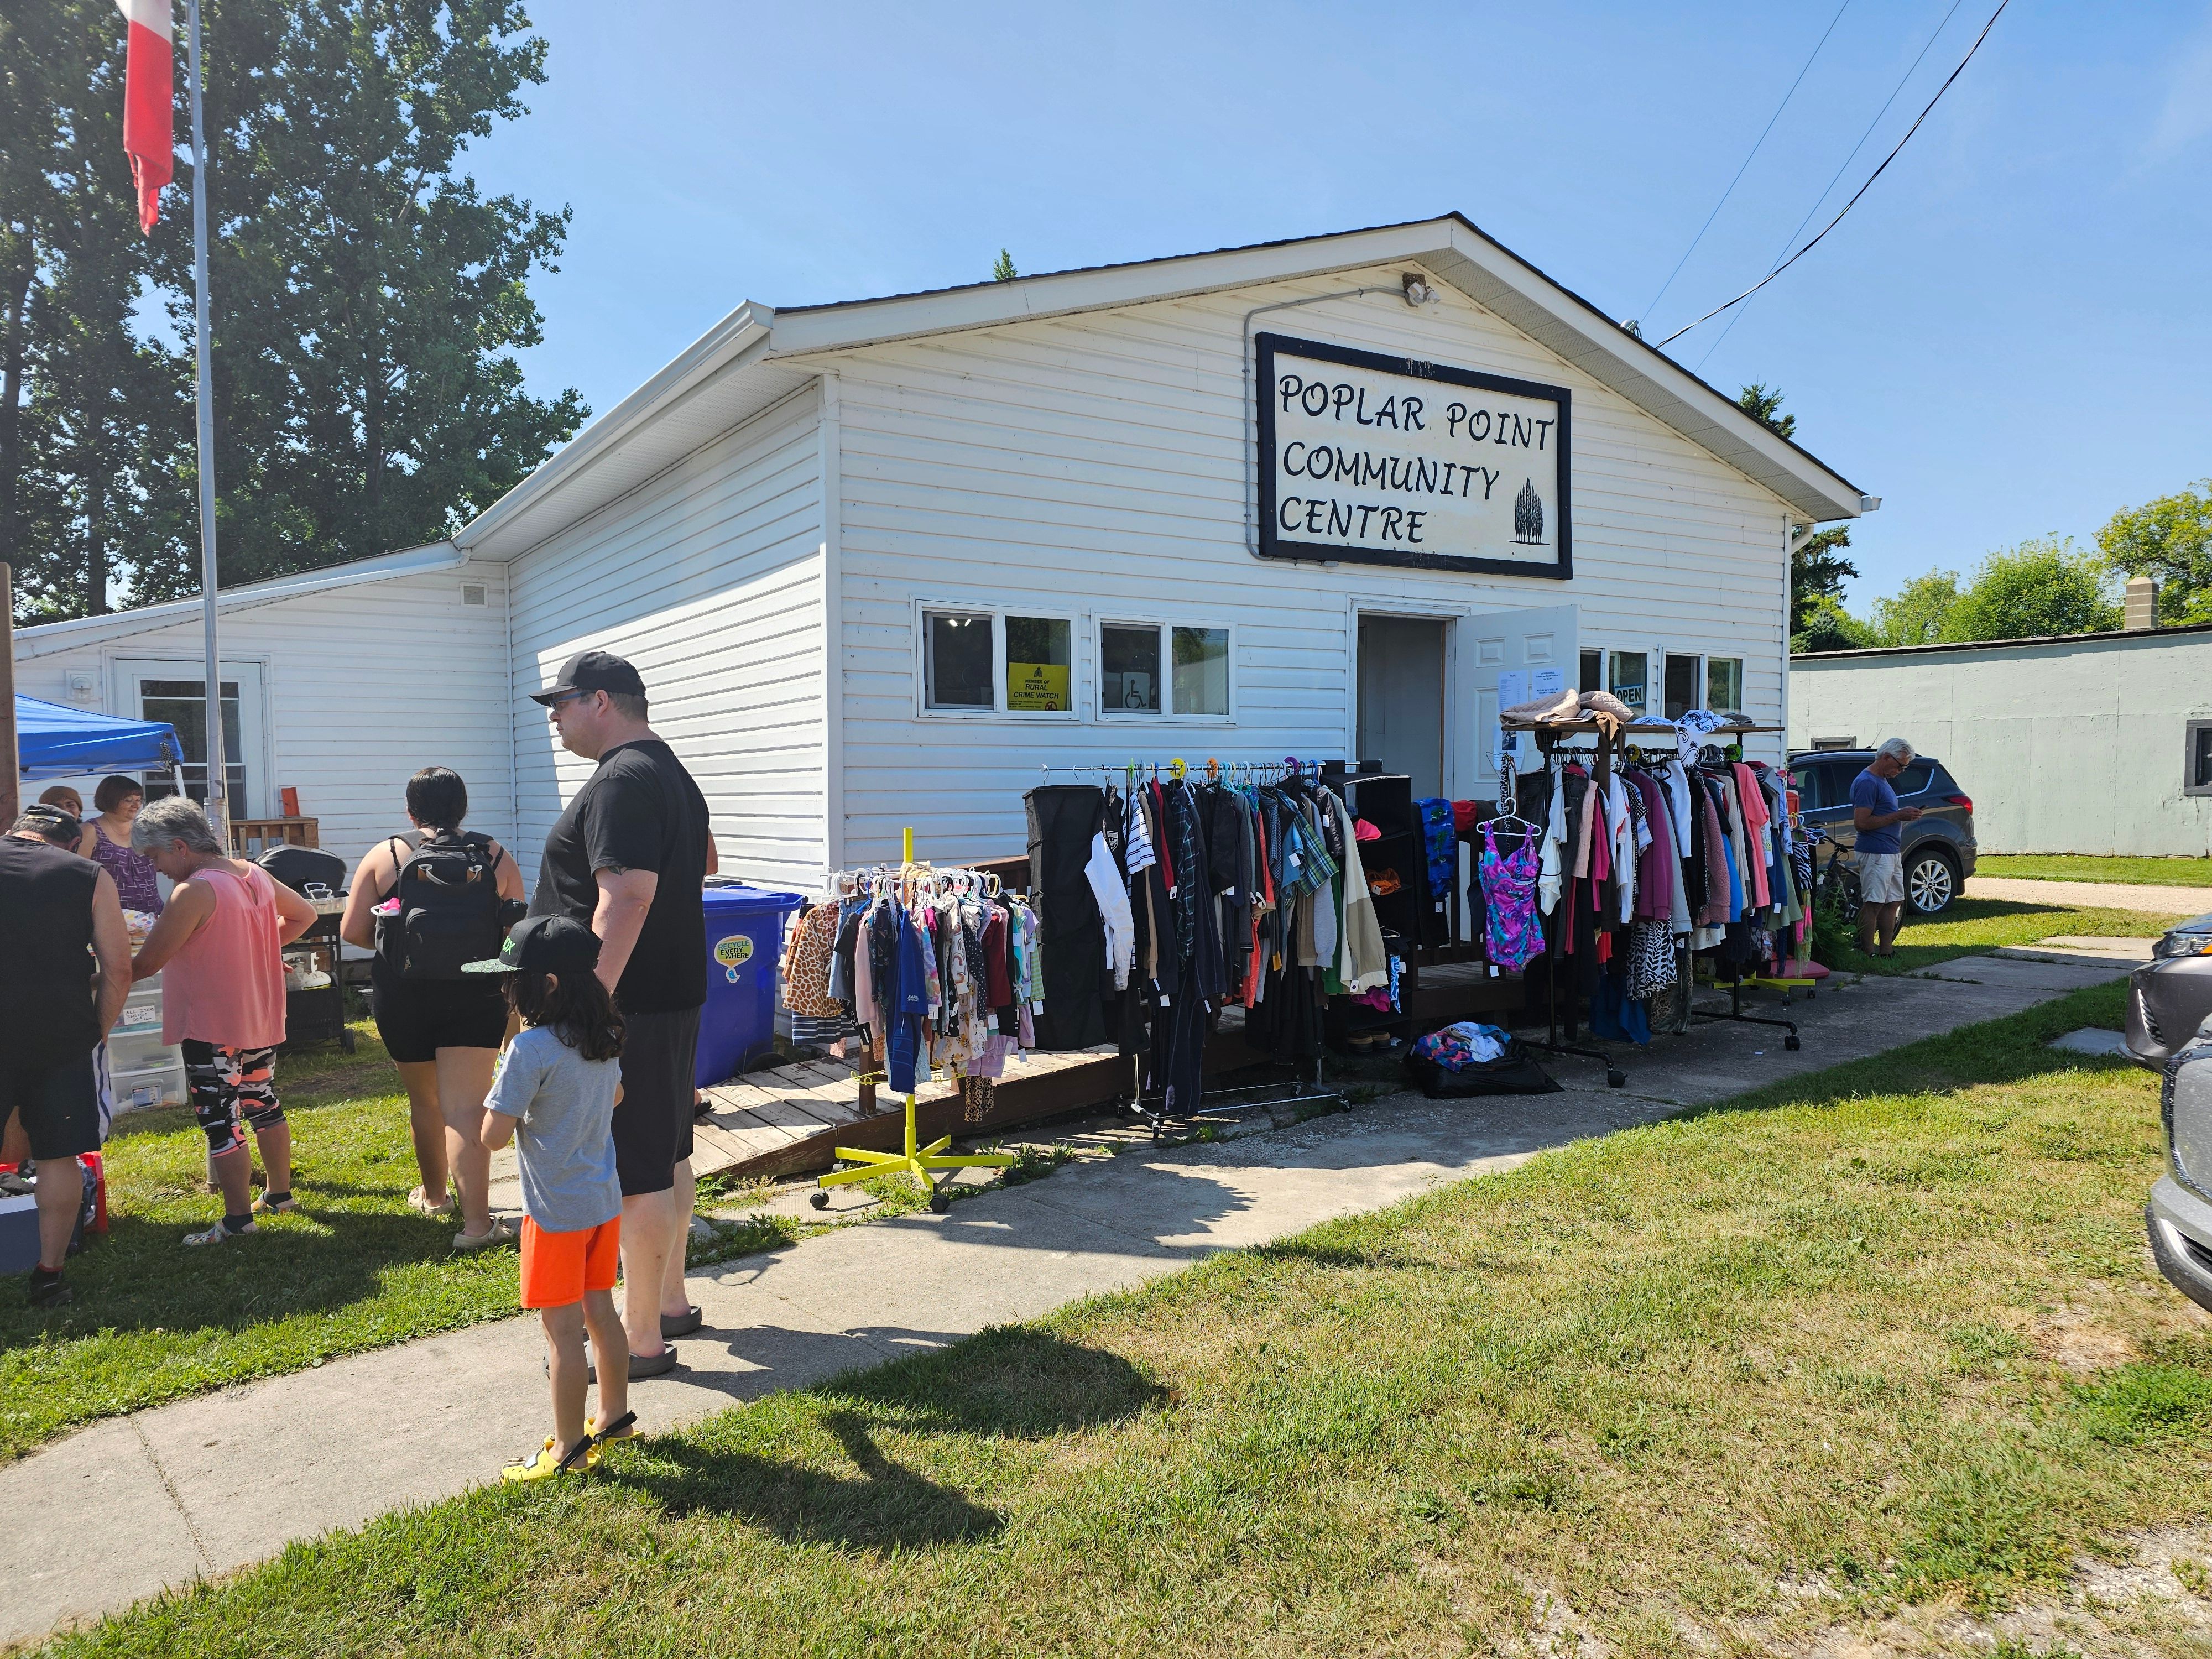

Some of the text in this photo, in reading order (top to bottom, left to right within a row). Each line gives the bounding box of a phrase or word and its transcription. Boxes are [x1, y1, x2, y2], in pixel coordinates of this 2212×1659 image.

[1280, 374, 1554, 451] POPLAR POINT
[1284, 441, 1500, 500] COMMUNITY
[1279, 496, 1427, 544] CENTRE
[1616, 687, 1642, 703] OPEN
[502, 935, 516, 956] OX
[718, 940, 750, 950] RECYCLE
[721, 947, 743, 956] EVERY
